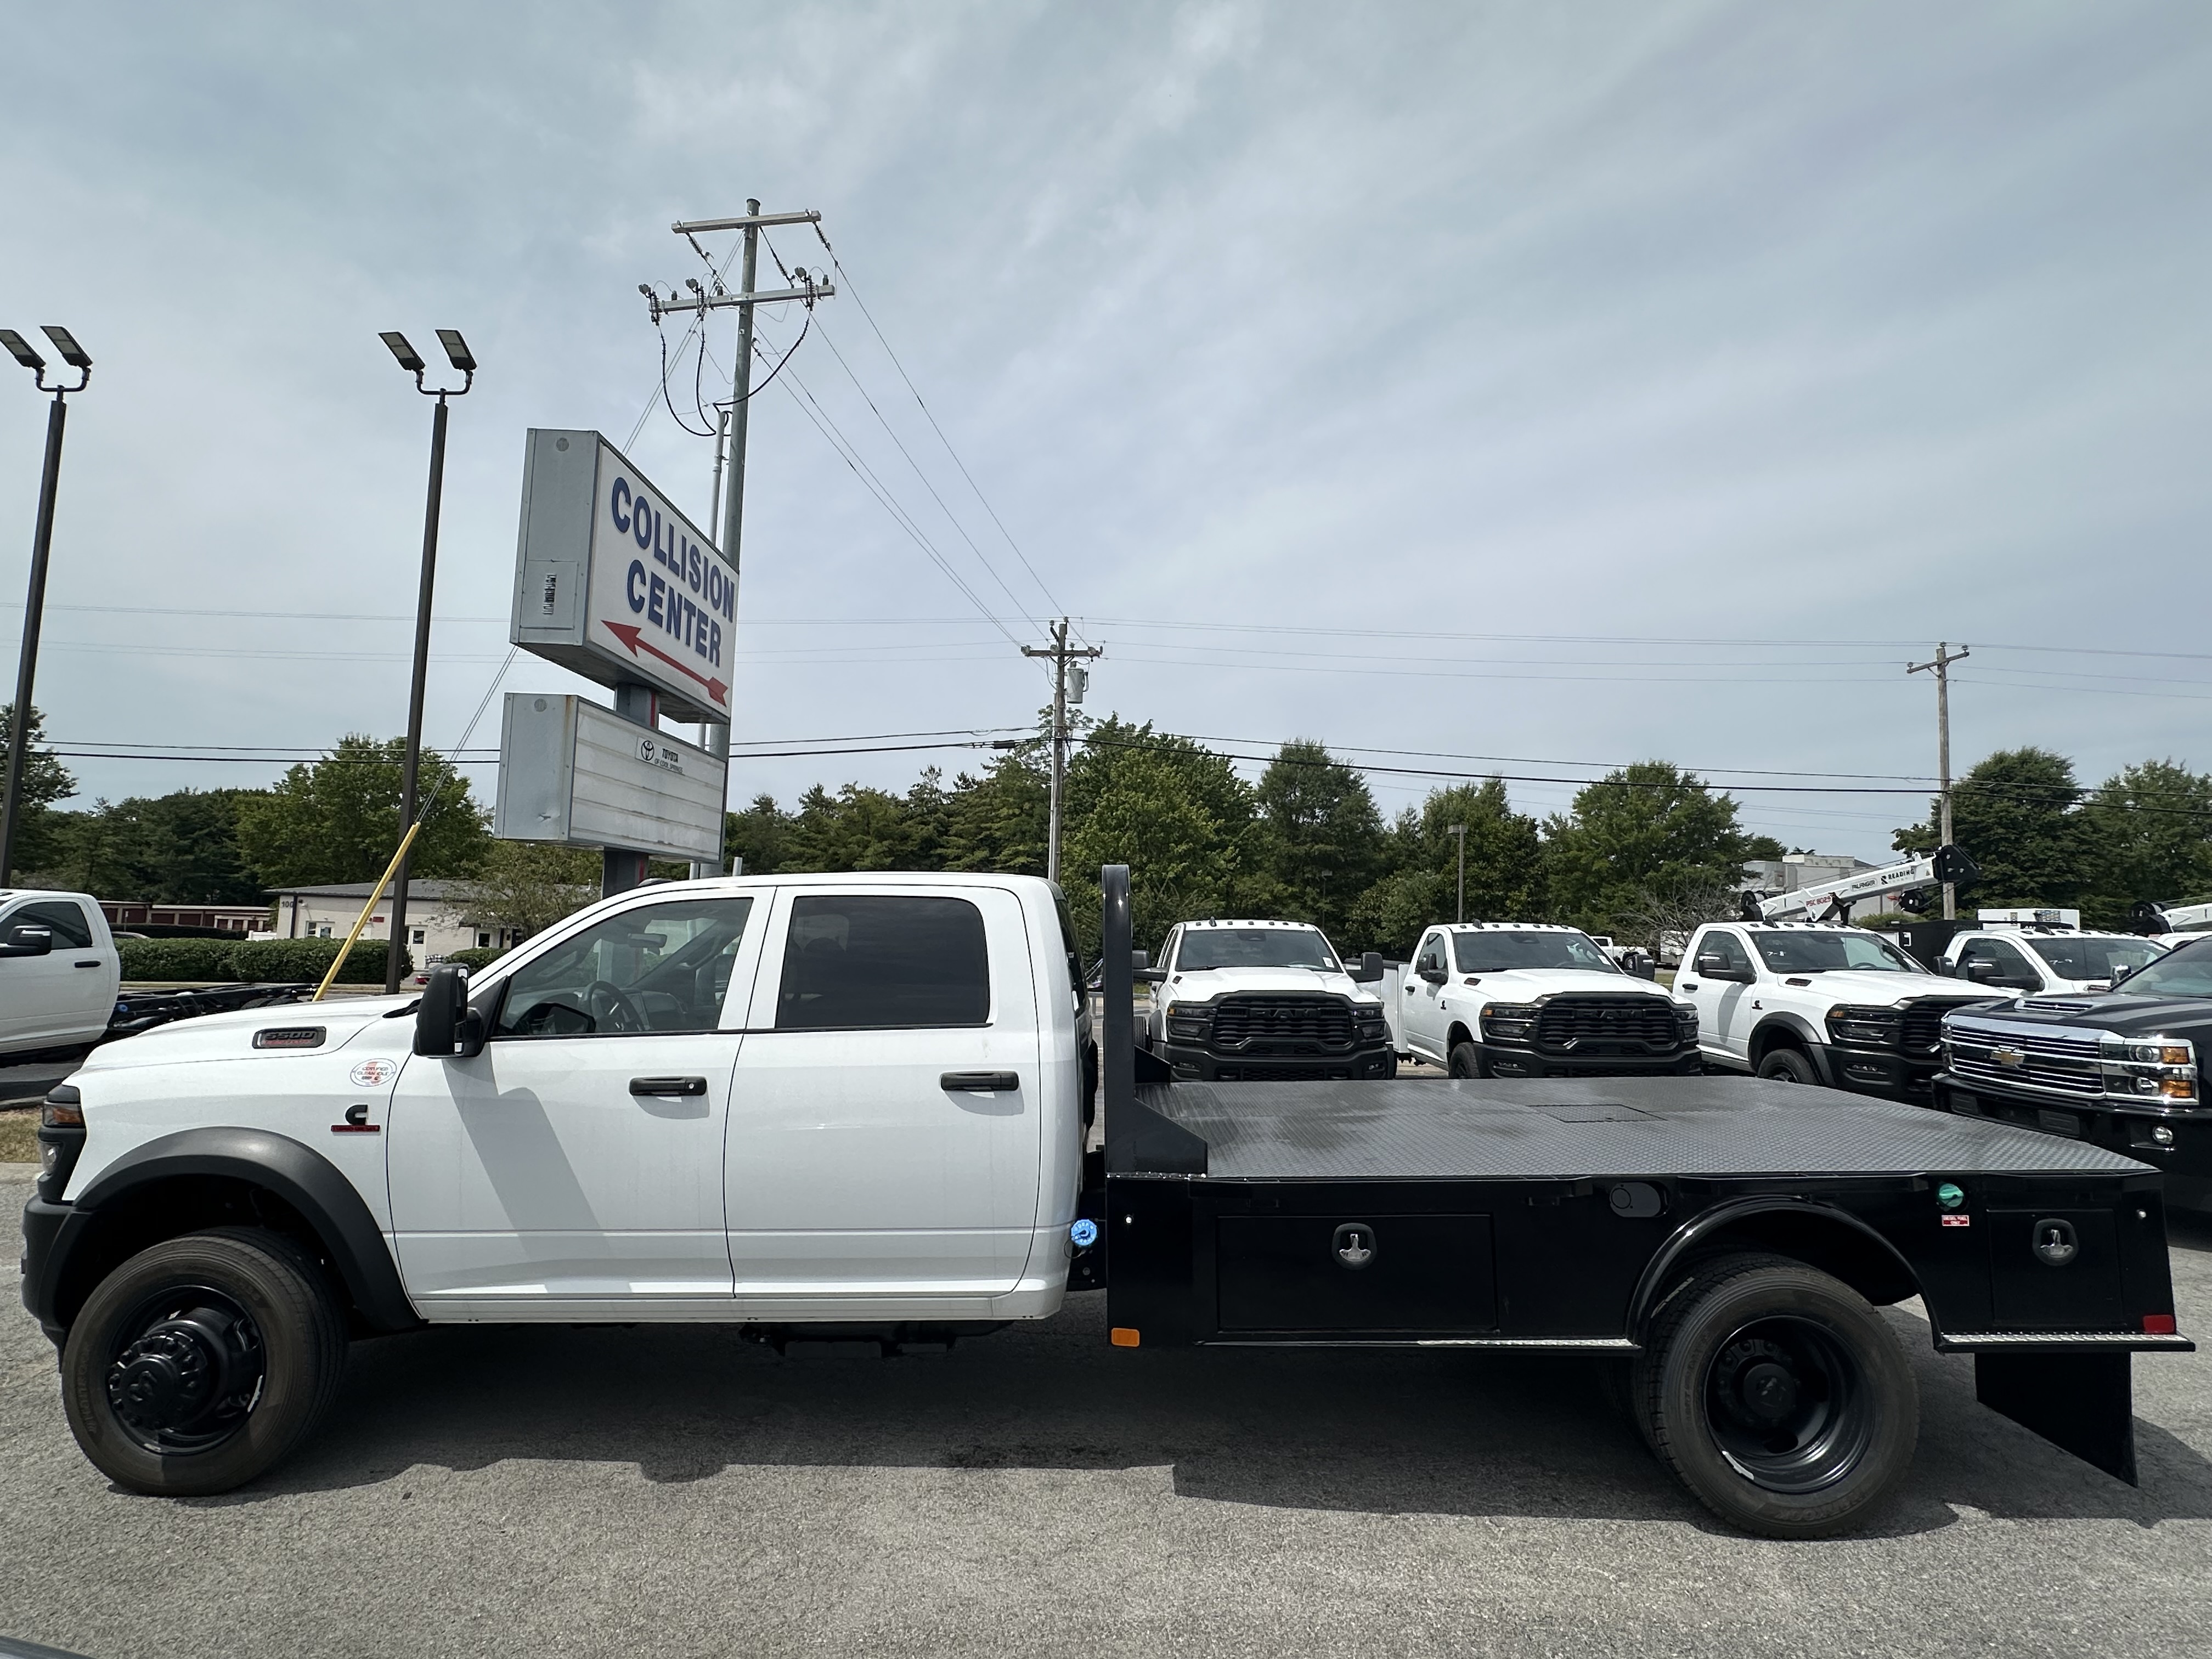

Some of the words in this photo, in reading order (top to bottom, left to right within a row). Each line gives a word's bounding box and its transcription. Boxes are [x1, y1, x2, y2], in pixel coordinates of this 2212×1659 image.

[611, 477, 735, 623] COLLISION
[627, 559, 721, 668] CENTER
[662, 748, 678, 763] TOYOTA
[1888, 868, 1915, 880] READING
